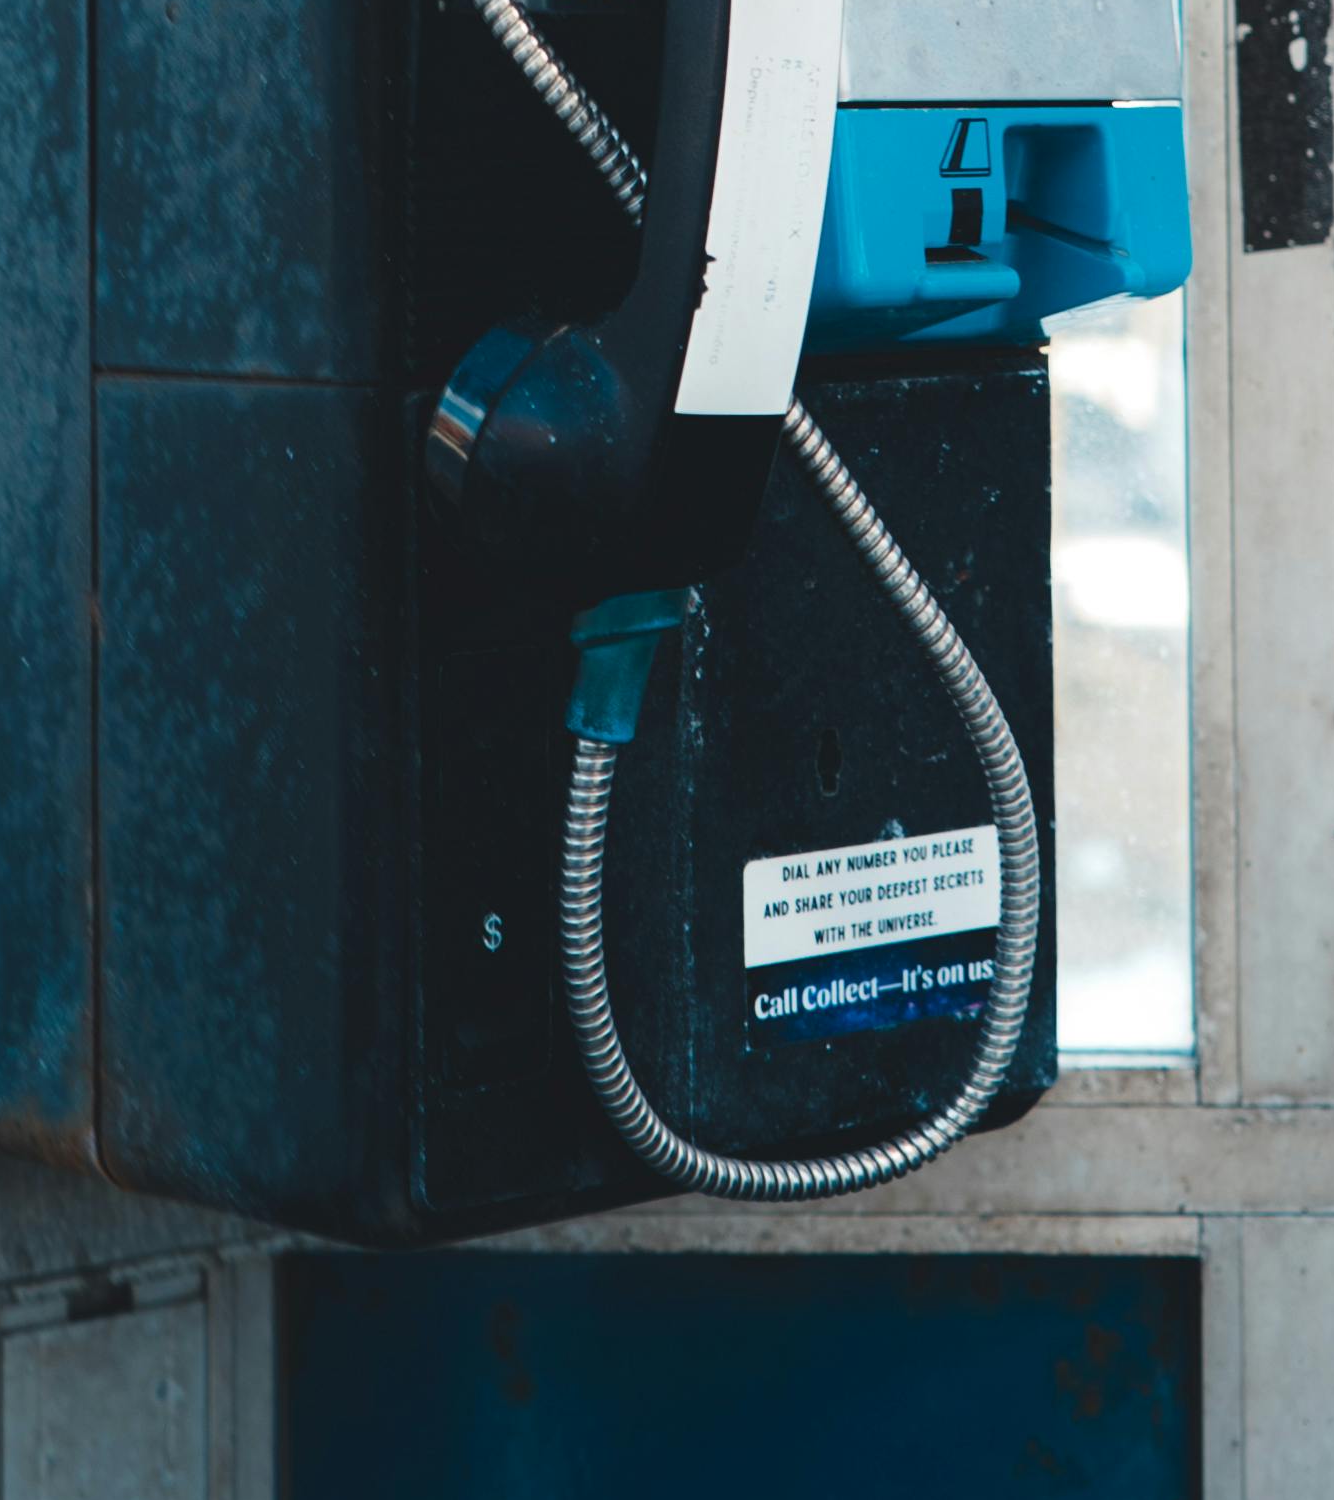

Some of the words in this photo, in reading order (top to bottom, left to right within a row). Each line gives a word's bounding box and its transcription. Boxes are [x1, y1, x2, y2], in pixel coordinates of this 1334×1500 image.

[782, 862, 810, 882] DIAL
[816, 858, 841, 877] ANY
[847, 850, 897, 872] NUMBER
[903, 849, 927, 865] YOU
[932, 838, 974, 858] PLEASE
[764, 900, 789, 919] AND
[795, 894, 833, 914] SHARE
[840, 888, 872, 907] YOUR
[878, 878, 928, 901] DEEPEST
[933, 869, 984, 891] SECRETS
[482, 911, 503, 953] $
[814, 926, 845, 946] WITH
[852, 921, 872, 939] THE
[878, 910, 938, 935] UNIVERSE.
[754, 986, 798, 1021] Call
[936, 964, 966, 986] on
[968, 958, 996, 981] us
